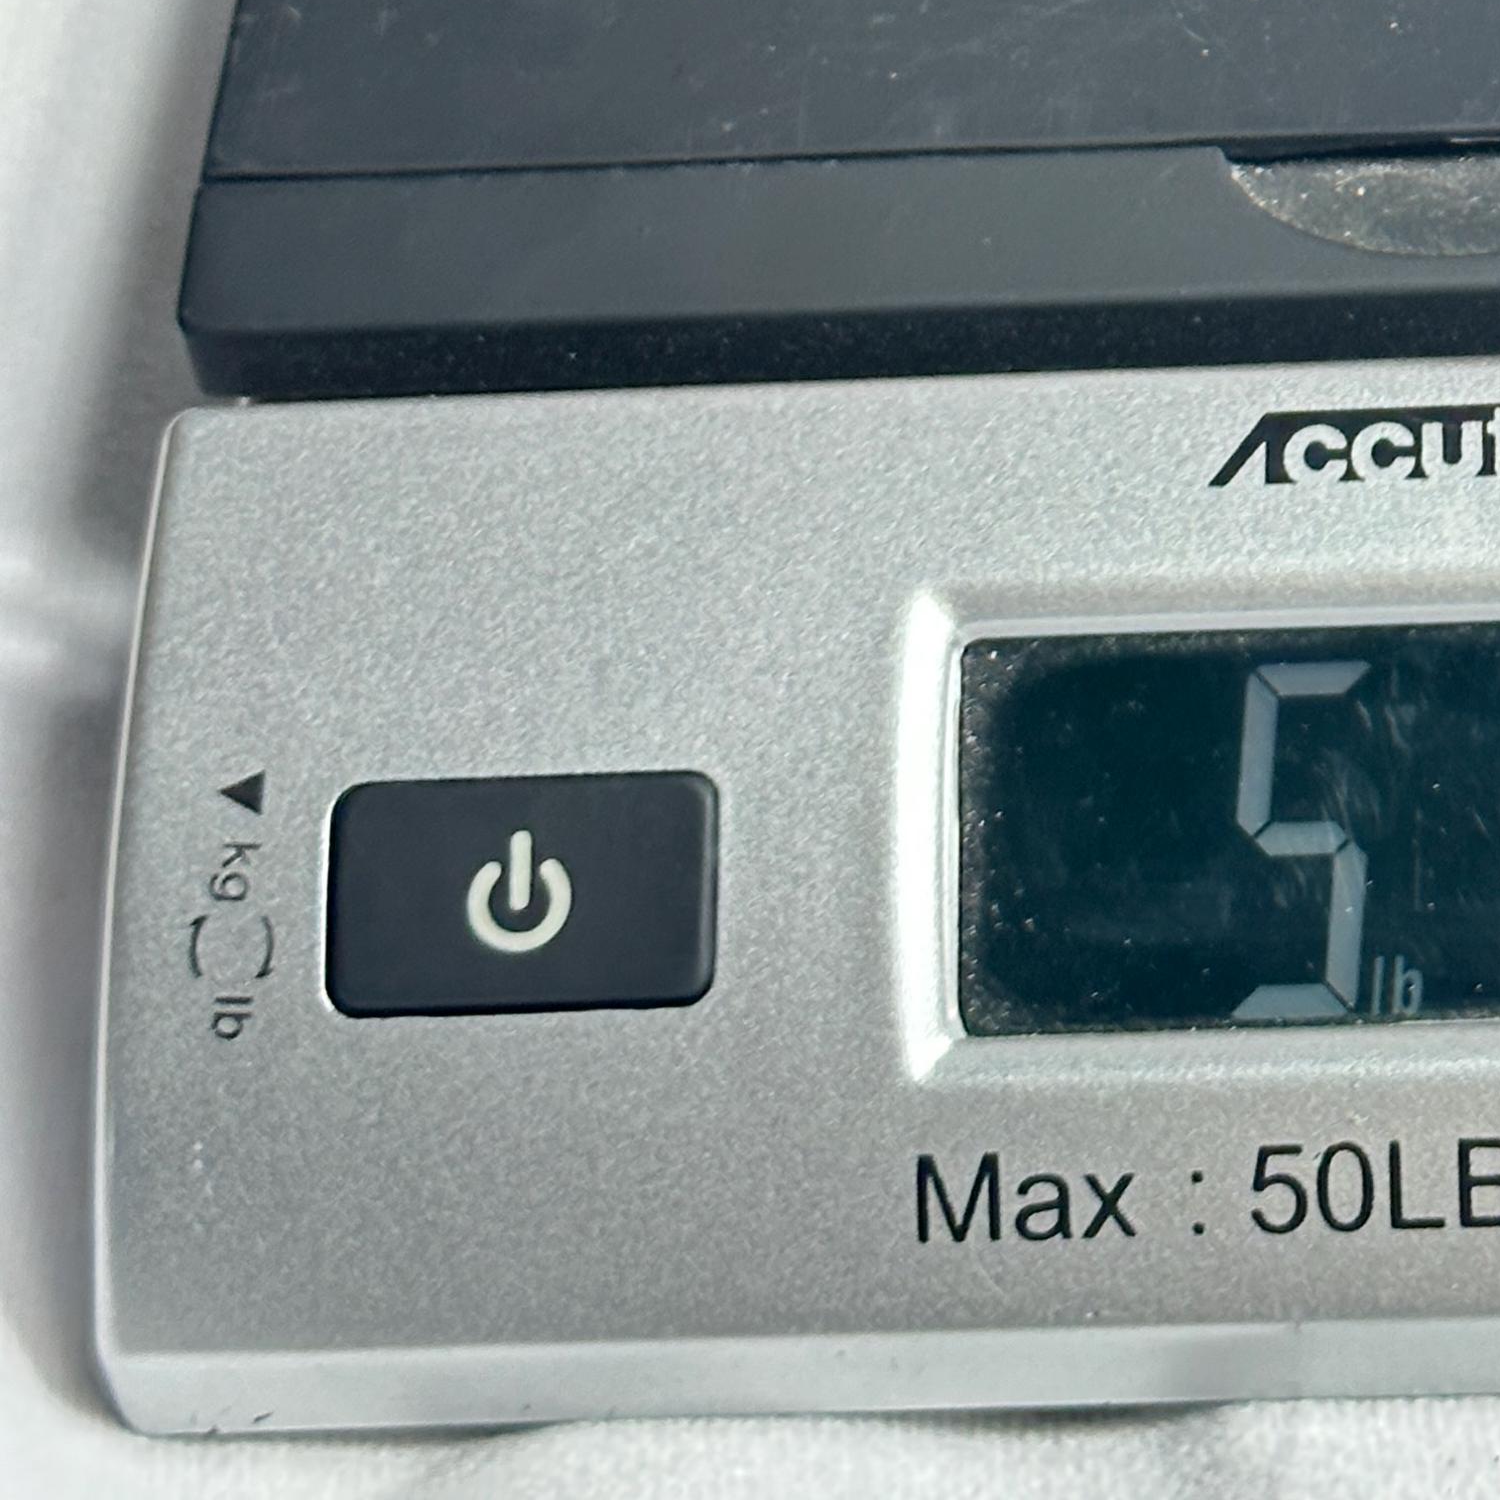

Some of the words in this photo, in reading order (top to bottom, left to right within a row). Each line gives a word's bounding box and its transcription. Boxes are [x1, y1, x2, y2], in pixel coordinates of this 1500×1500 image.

[209, 841, 262, 901] kg
[1232, 661, 1371, 1020] 5
[1371, 955, 1424, 1017] lb
[210, 995, 254, 1041] lb
[914, 1150, 1138, 1244] Max
